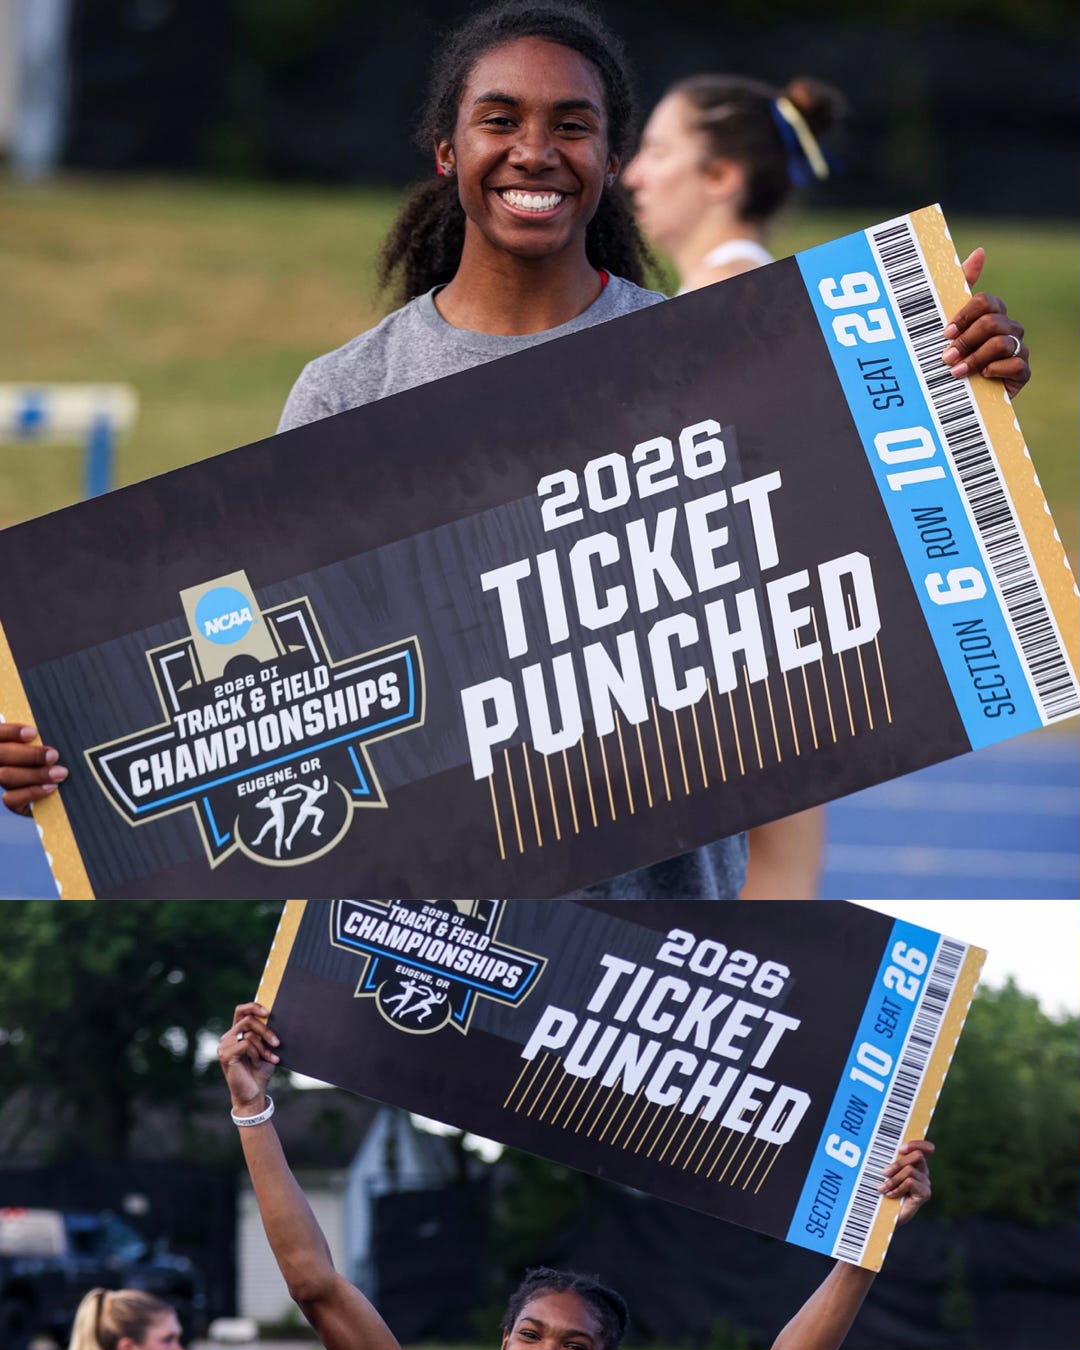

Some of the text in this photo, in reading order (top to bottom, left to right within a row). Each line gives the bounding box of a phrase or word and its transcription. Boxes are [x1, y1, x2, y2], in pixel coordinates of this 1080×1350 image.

[537, 419, 727, 532] 2026
[818, 271, 1016, 719] SECTION 6 ROW 10 SEAT 26
[480, 470, 782, 660] TICKET
[204, 607, 252, 636] NCAA
[174, 665, 330, 739] TRACK & FIELD
[214, 675, 255, 698] 2026
[460, 551, 881, 781] PUNCHED
[129, 671, 401, 797] CHAMPIONSHIPS
[237, 758, 321, 797] EUGENE, OR
[344, 911, 523, 989] CHAMPIONSHIPS
[388, 904, 490, 951] TRACK & FIELD
[422, 905, 448, 921] 2026
[395, 965, 450, 989] EUGENE, OR
[655, 928, 791, 999] 2026
[586, 953, 801, 1069] TICKET
[520, 1004, 812, 1145] PUNCHED
[805, 940, 928, 1239] SECTION 6 ROW 10 SEAT 26
